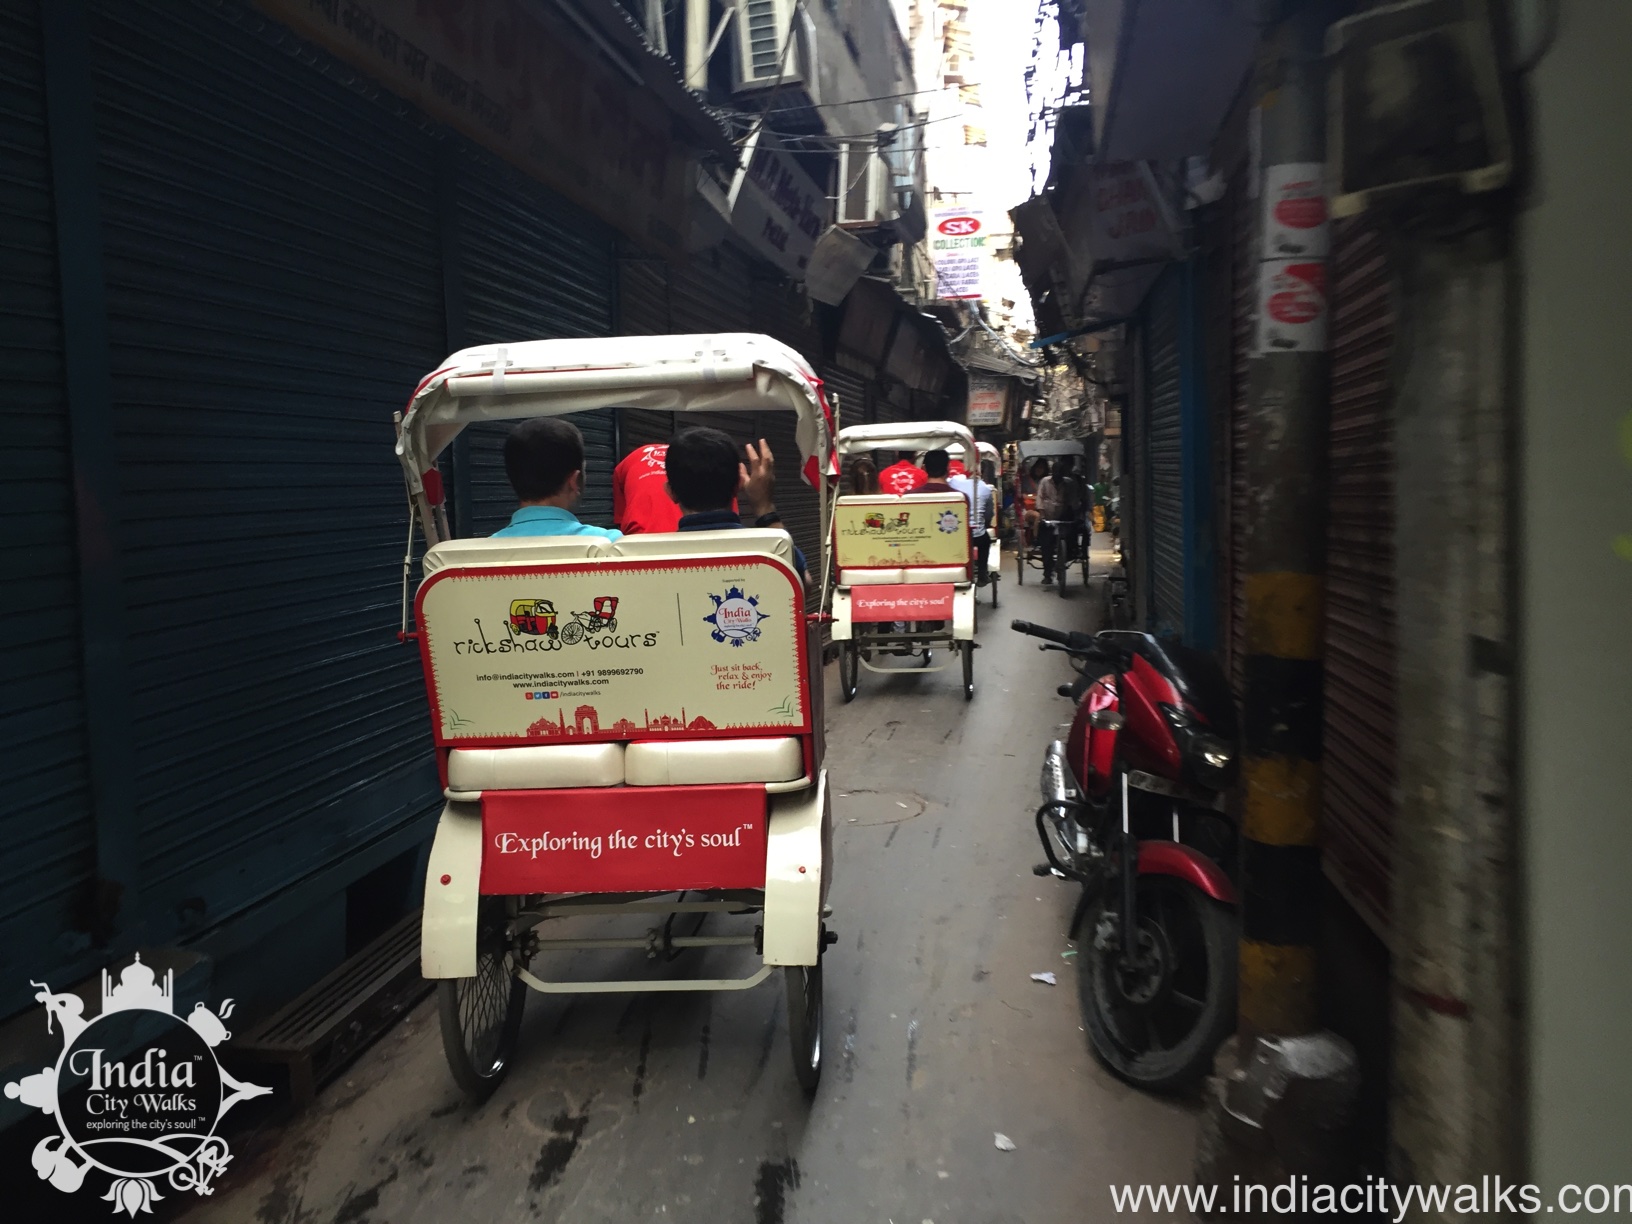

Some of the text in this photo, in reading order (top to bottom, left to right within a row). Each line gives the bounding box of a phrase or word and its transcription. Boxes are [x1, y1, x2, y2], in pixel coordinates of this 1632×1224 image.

[944, 220, 974, 234] SK
[857, 597, 945, 609] Exploring the city's soul
[718, 607, 751, 618] India
[453, 618, 657, 654] rickshaw tours
[476, 670, 575, 681] info@indiacitywalks.com
[597, 668, 644, 677] 9899692790
[710, 664, 729, 675] Just
[718, 672, 772, 682] relax & enjoy
[512, 678, 609, 688] www.indiacitywalks.com
[716, 680, 756, 690] the ride!
[494, 831, 602, 860] Exploring
[607, 829, 638, 849] the
[644, 828, 695, 857] city's
